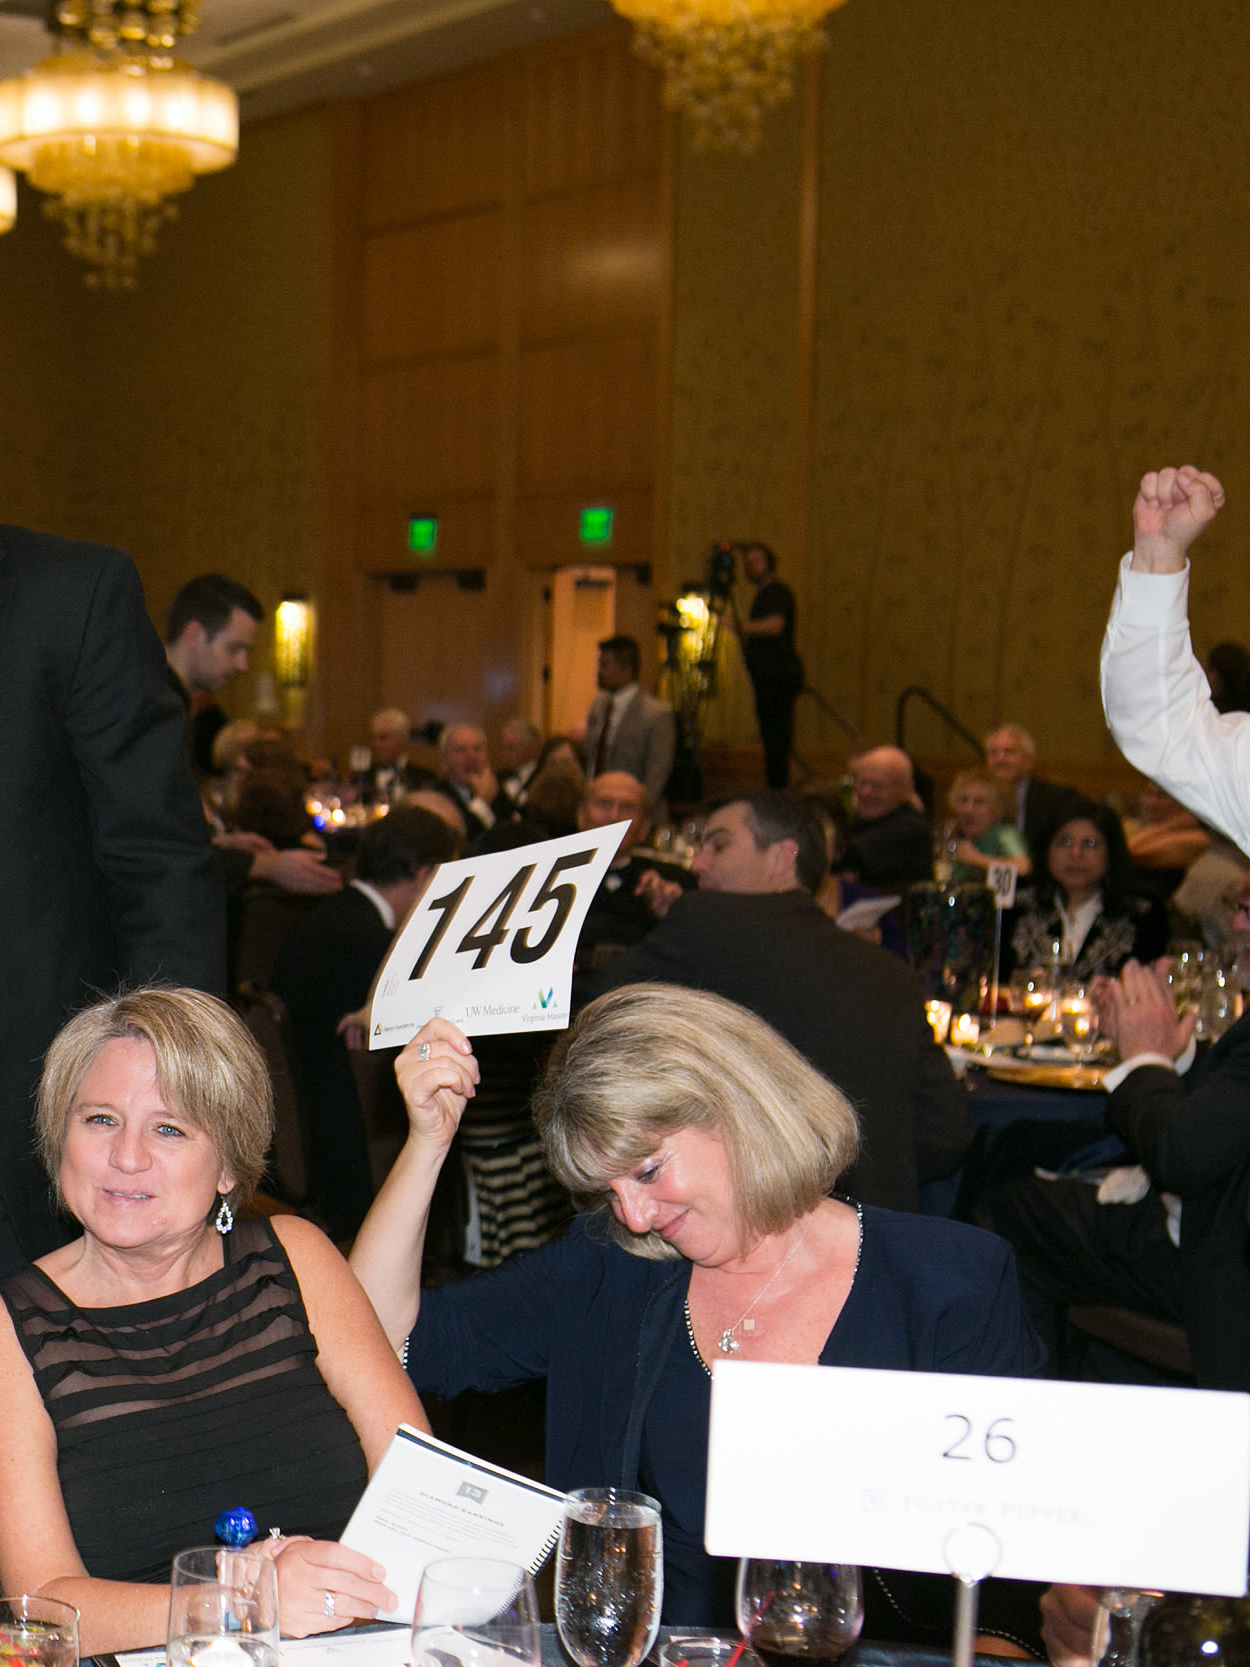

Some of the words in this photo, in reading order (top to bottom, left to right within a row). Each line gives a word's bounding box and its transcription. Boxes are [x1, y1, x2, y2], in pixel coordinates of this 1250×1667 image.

[408, 847, 599, 981] 145
[465, 1003, 484, 1018] UW
[483, 1002, 520, 1017] Medicine
[941, 1412, 1017, 1464] 26
